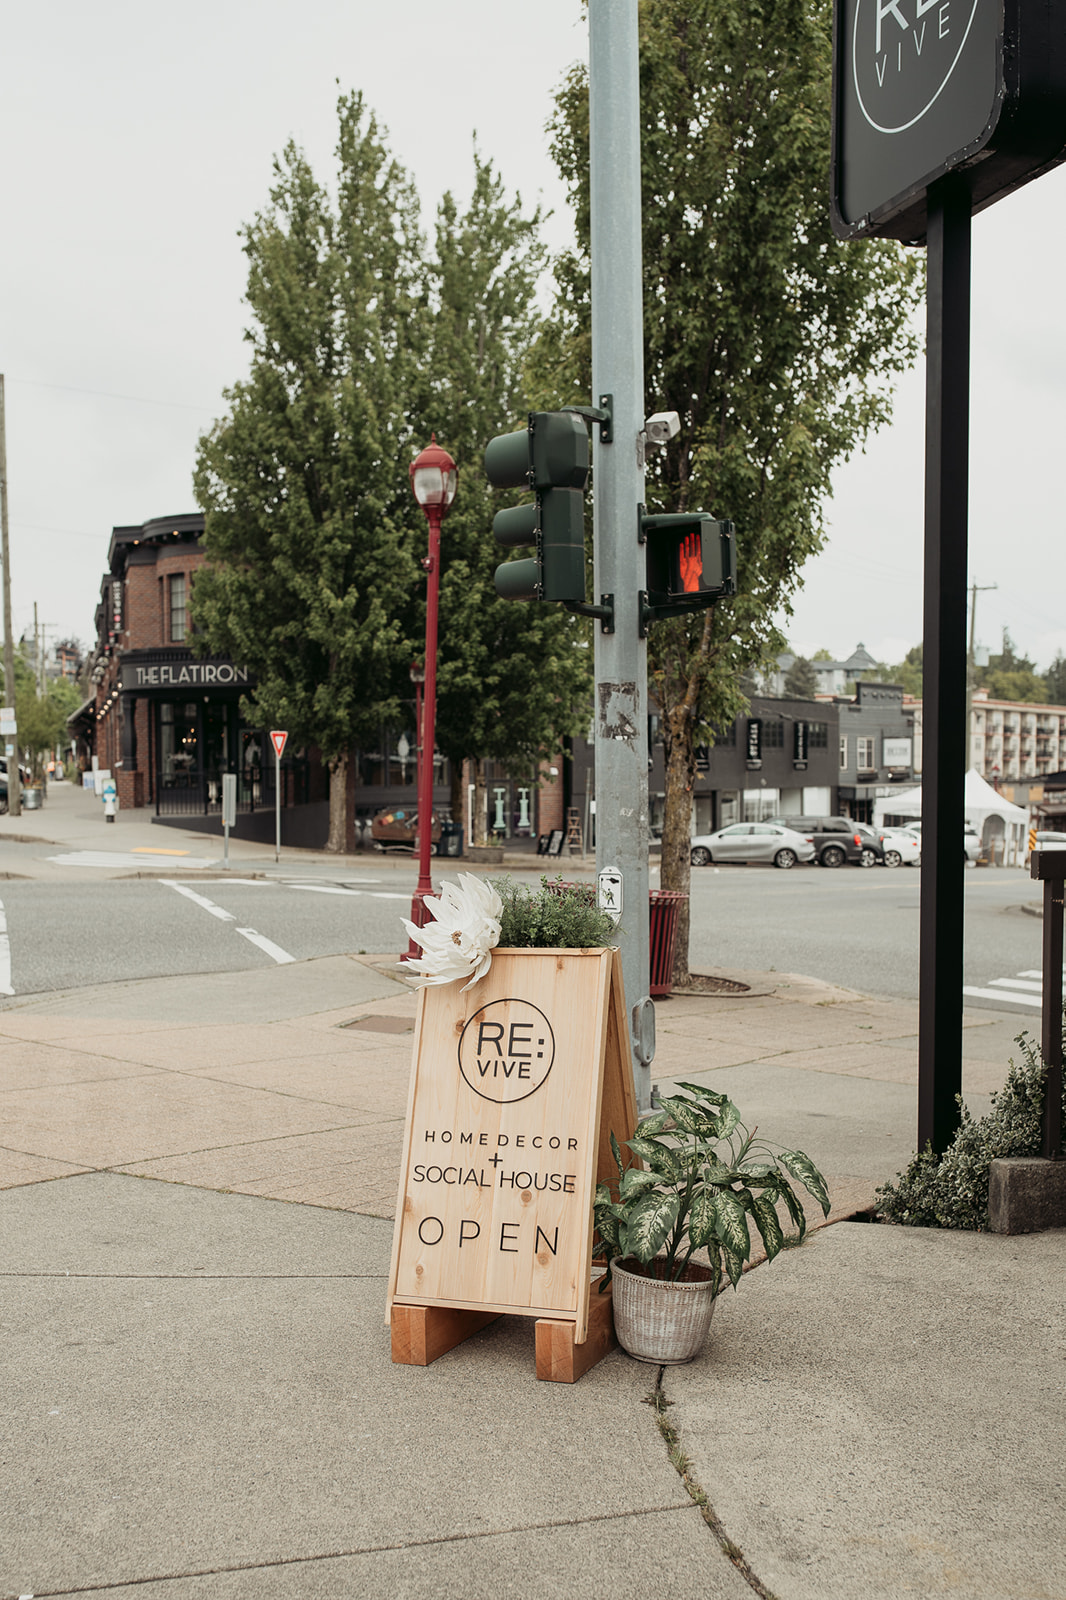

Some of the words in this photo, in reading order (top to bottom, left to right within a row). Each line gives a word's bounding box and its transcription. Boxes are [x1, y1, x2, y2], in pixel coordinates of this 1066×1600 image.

[876, 2, 950, 87] VIVE
[136, 666, 159, 684] THE
[160, 664, 248, 684] FLATIRON
[477, 1021, 545, 1058] RE:
[477, 1059, 532, 1079] VIVE
[425, 1130, 489, 1146] HOME
[497, 1134, 578, 1150] DECOR
[413, 1165, 491, 1188] SOCIAL
[499, 1170, 577, 1193] HOUSE
[418, 1216, 559, 1256] OPEN
